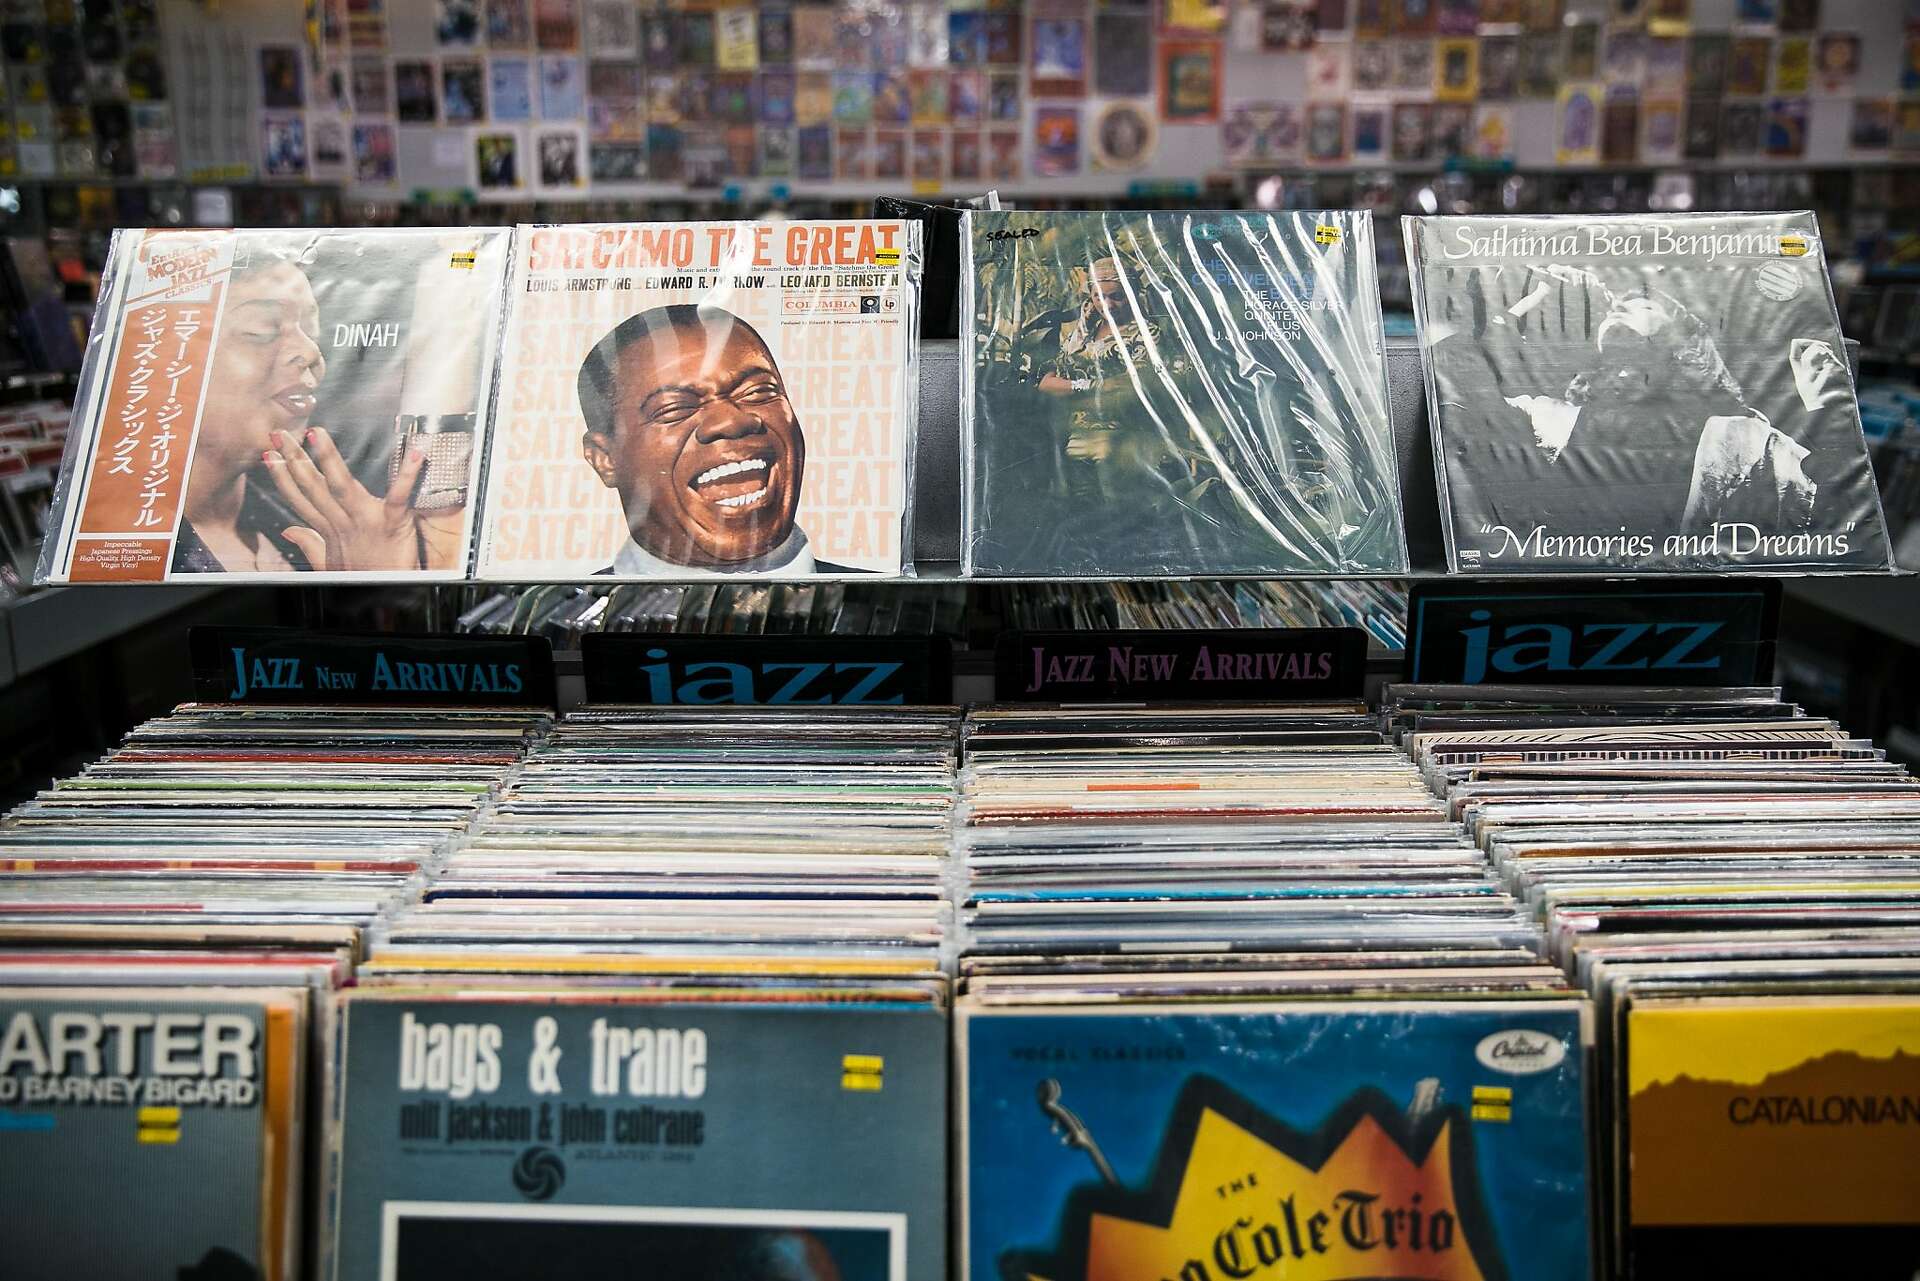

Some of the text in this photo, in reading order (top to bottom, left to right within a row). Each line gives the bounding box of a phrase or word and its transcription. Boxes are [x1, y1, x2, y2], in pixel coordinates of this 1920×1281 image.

[529, 228, 695, 271] SATCHMO
[785, 224, 900, 267] GREAT
[986, 228, 1040, 242] SEALED
[1443, 223, 1782, 263] Sathima Bea Benjami
[526, 278, 559, 293] LOUIS
[645, 276, 693, 290] EDWARD
[698, 276, 709, 289] R.
[836, 273, 899, 287] BERNSTEN
[332, 323, 400, 348] DINAH
[104, 540, 143, 549] Impeccable
[1662, 522, 1721, 557] and
[1458, 609, 1727, 684] jazz
[230, 647, 524, 699] JAZZ NEW ARRIVALS
[639, 648, 905, 705] jazz
[1025, 645, 1333, 693] JAZZ NEW ARRIVALS
[0, 1012, 257, 1078] ARTER
[399, 1012, 708, 1099] bags & trane
[22, 1078, 143, 1102] BARNEY
[146, 1080, 255, 1104] BIGARD
[1727, 1094, 1920, 1126] CATALONIAN
[400, 1101, 706, 1147] milt jackson & john coltrane
[1216, 1172, 1259, 1200] THE
[1212, 1189, 1456, 1280] Cole Trio
